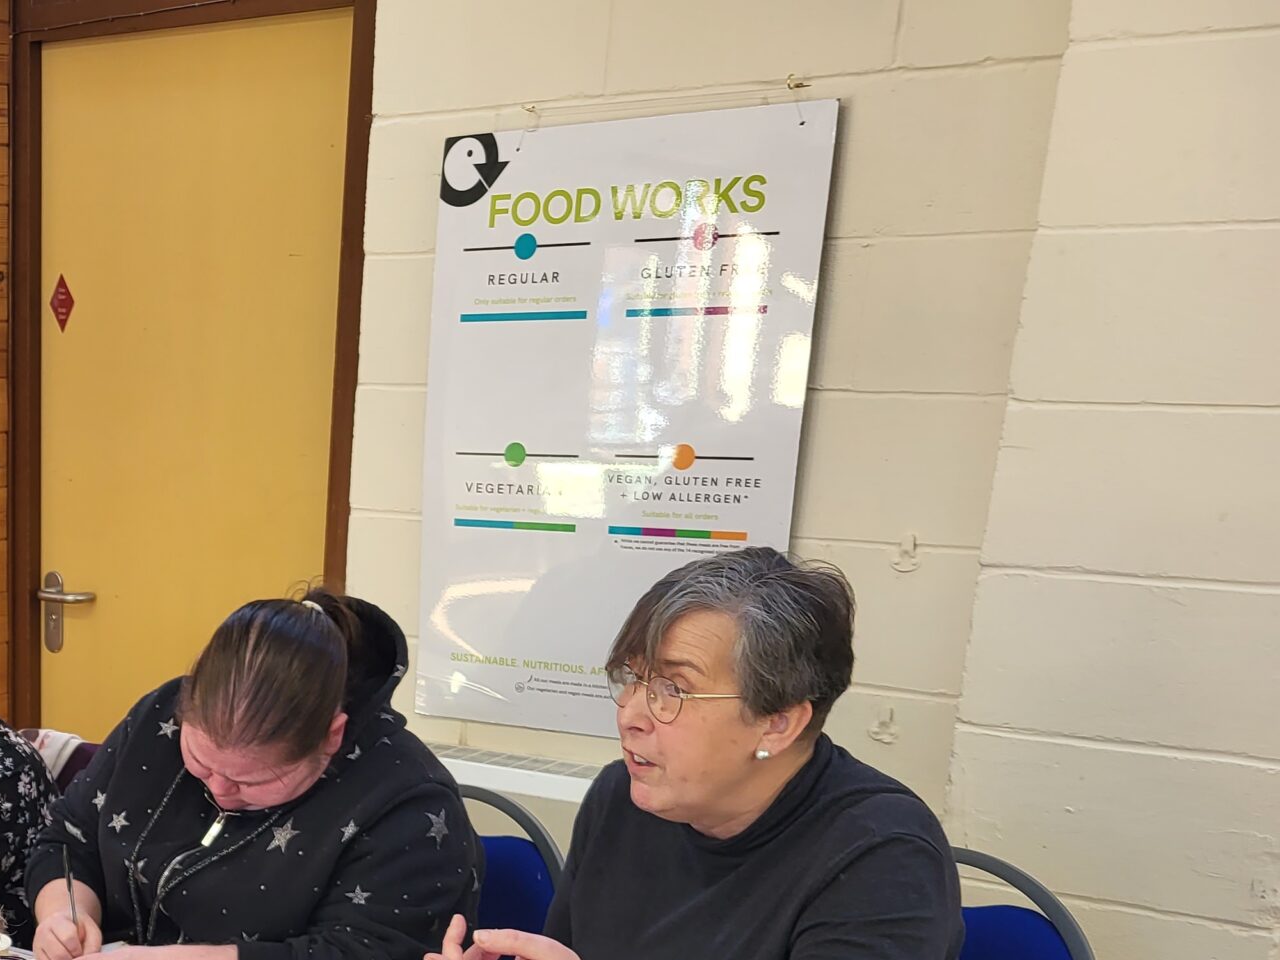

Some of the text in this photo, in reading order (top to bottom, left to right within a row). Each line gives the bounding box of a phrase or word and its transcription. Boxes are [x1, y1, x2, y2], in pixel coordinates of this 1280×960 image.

[488, 174, 767, 228] FOOD WORKS
[487, 271, 560, 286] REGULAR
[640, 265, 710, 279] GLUTEN
[607, 474, 762, 488] VEGAN, GLUTEN FREE
[465, 482, 562, 496] VEGETARIA
[633, 491, 663, 501] LOW
[641, 510, 719, 520] Suitable for all orders
